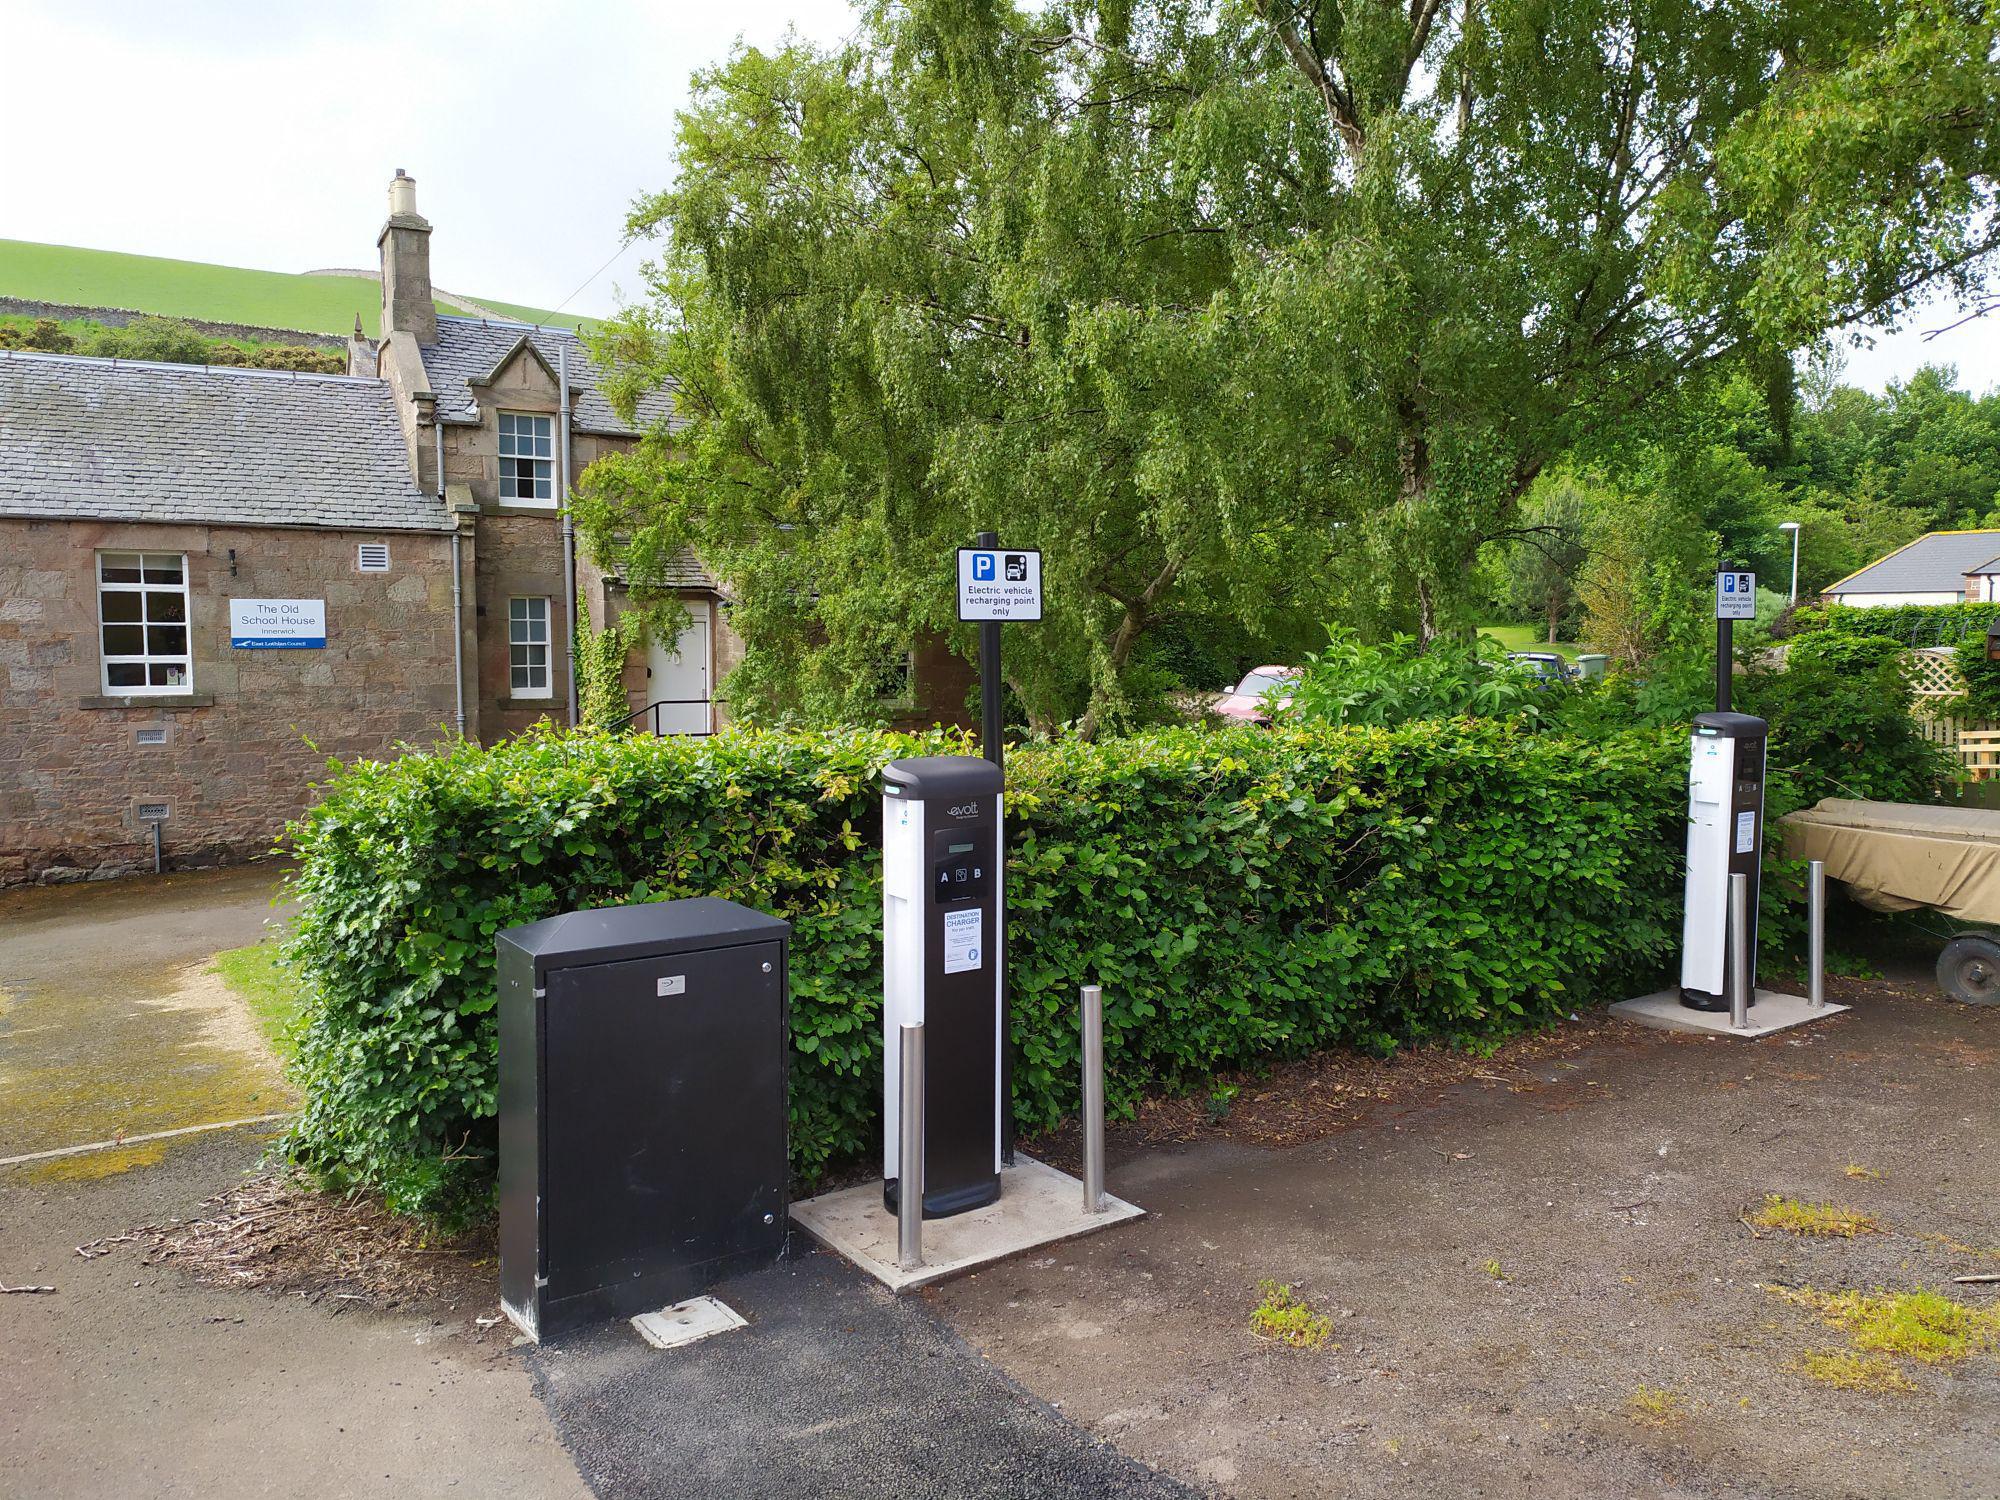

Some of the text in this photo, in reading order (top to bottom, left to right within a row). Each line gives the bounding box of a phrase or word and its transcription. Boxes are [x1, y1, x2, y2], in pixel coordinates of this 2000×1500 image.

[976, 556, 991, 578] P
[968, 586, 1033, 595] Electric vehicle
[965, 597, 1035, 605] recharging point
[257, 604, 299, 614] The Old
[992, 607, 1010, 617] only
[241, 615, 316, 625] School House
[947, 802, 978, 816] evolt
[940, 868, 981, 882] A B
[946, 911, 980, 921] DESTINATION
[946, 917, 980, 928] CHARGER
